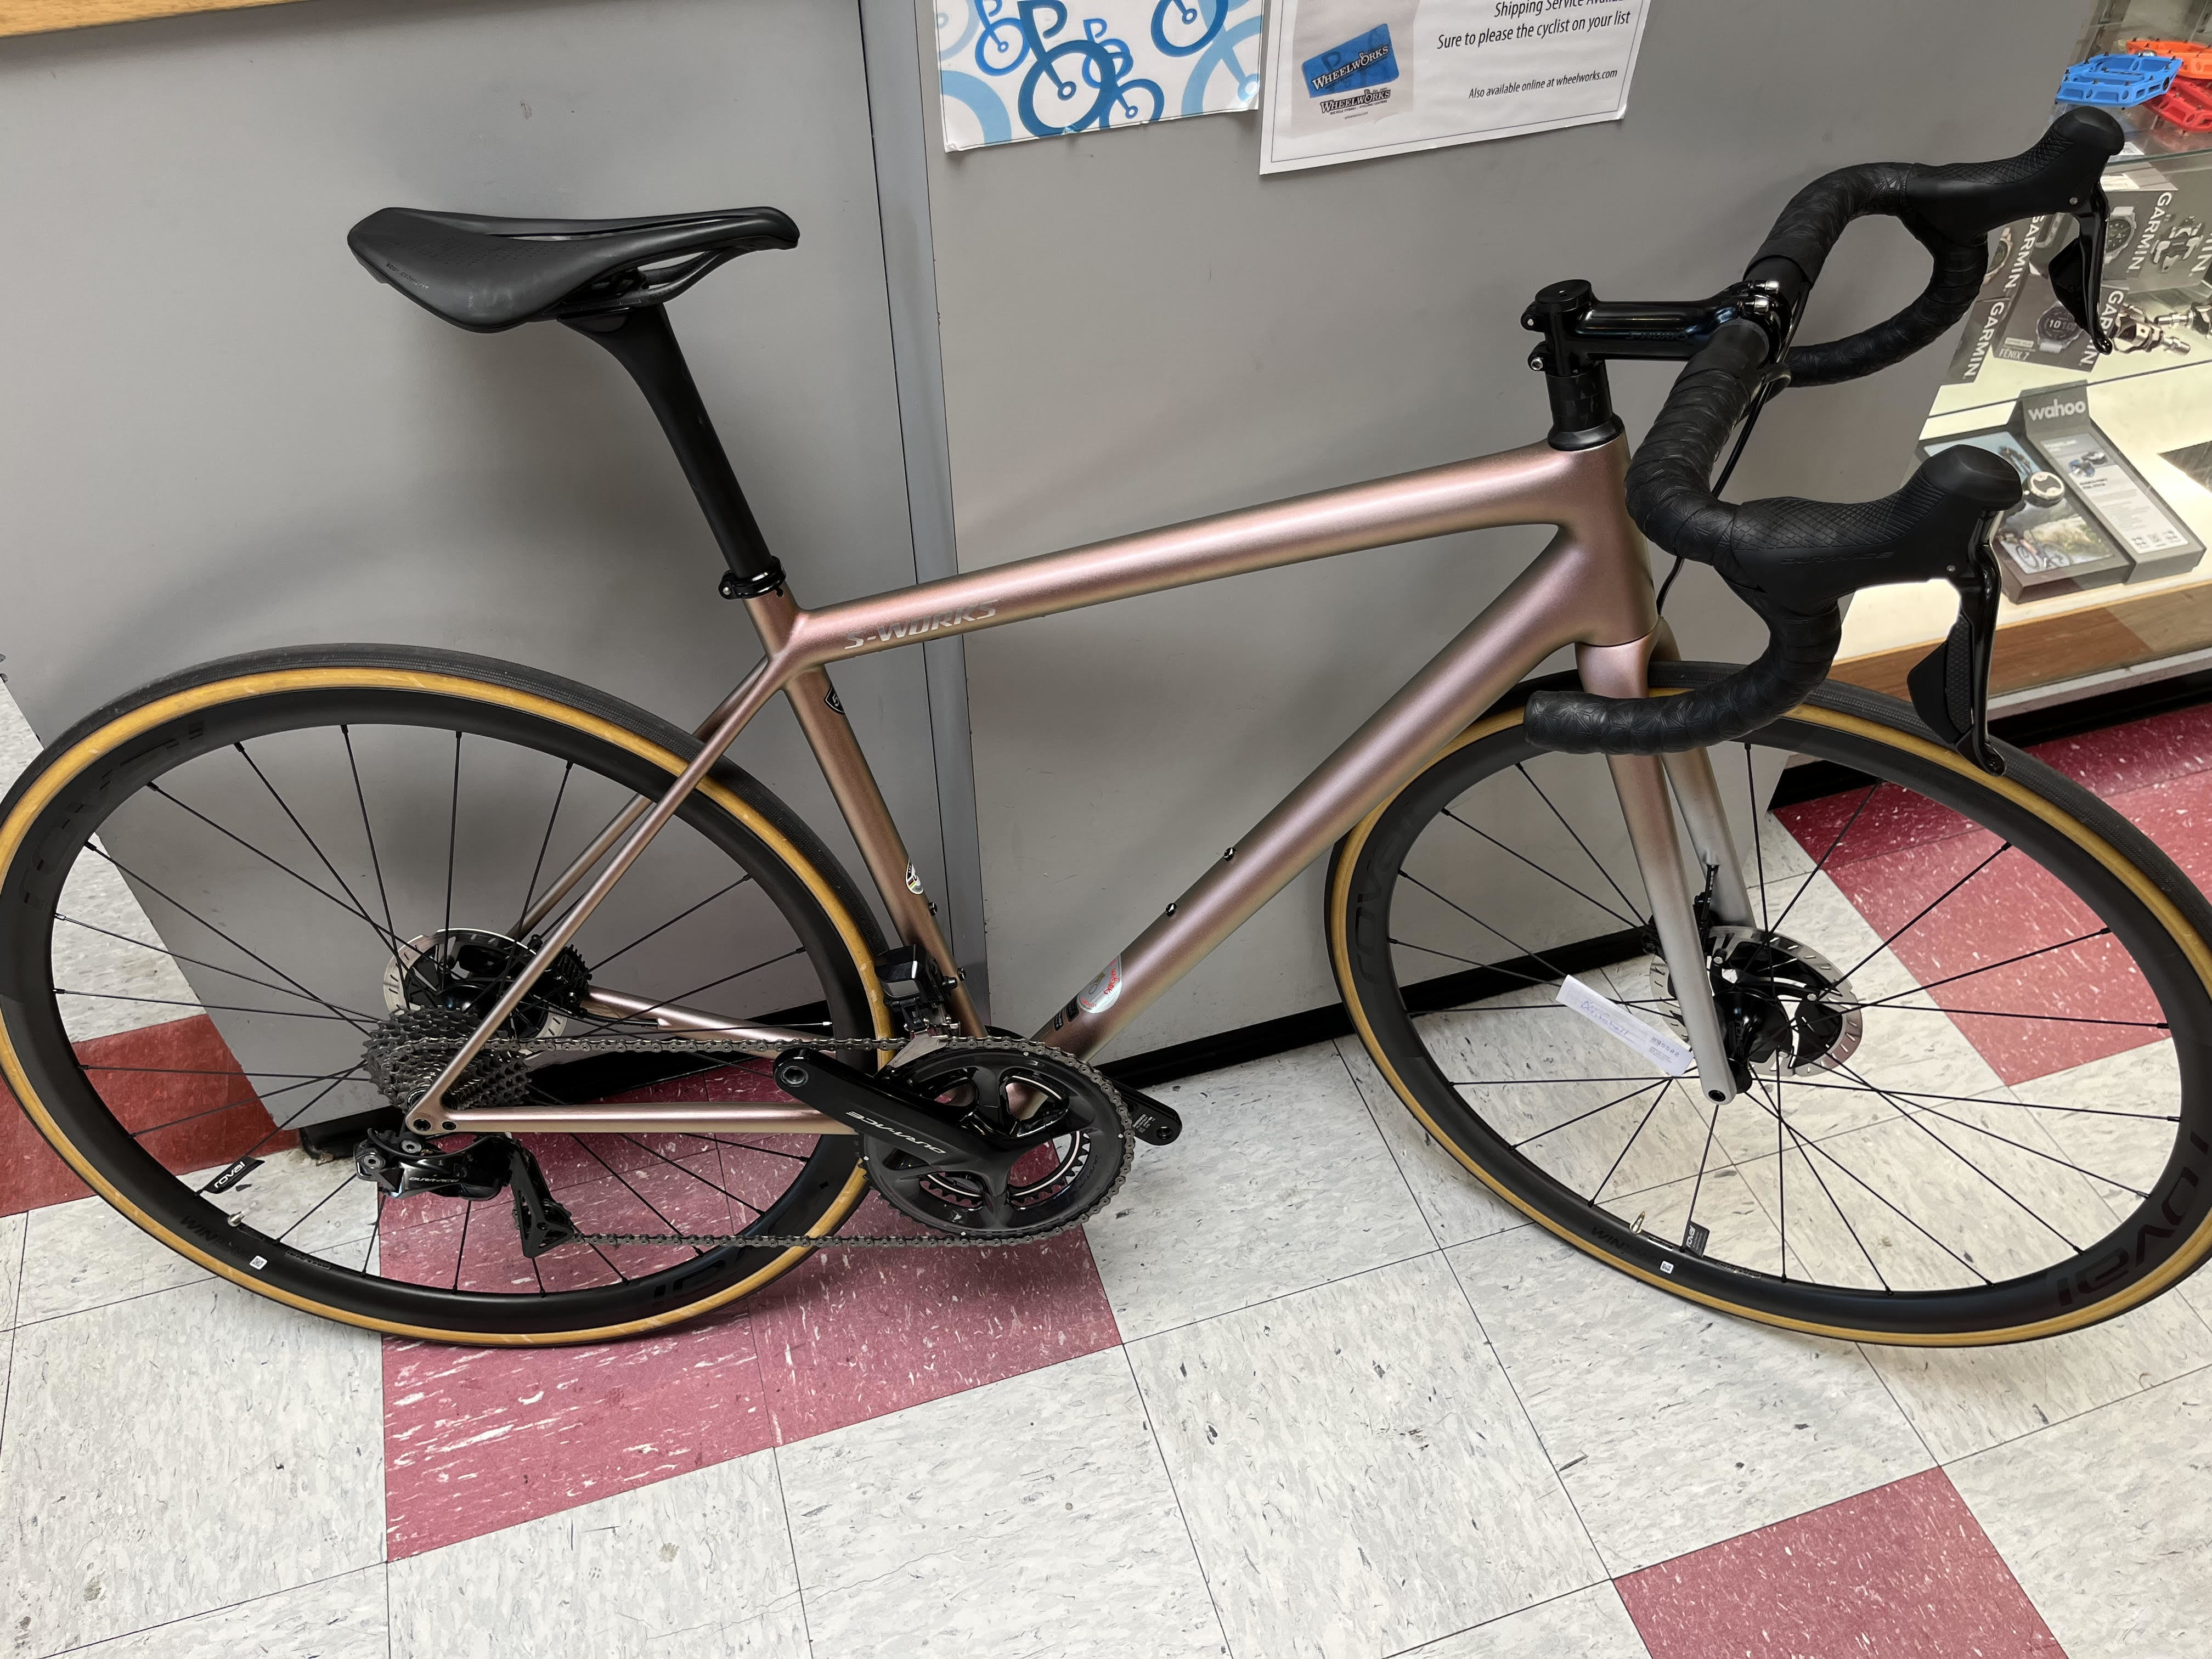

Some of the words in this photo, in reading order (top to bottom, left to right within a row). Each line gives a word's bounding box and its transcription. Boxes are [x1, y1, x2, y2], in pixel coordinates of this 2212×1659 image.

[1494, 1, 1542, 19] Shipping
[1437, 34, 1461, 49] Sure
[1464, 32, 1476, 45] to
[1478, 28, 1513, 47] please
[1516, 23, 1534, 39] the
[1537, 19, 1570, 38] cyclist
[1572, 18, 1585, 31] on
[1587, 15, 1612, 33] your
[1613, 10, 1630, 26] list
[1469, 88, 1485, 99] Also
[1486, 82, 1520, 97] available
[1522, 80, 1545, 92] online
[1546, 78, 1555, 88] at
[1556, 69, 1617, 87] wheelworks.com
[2128, 192, 2172, 272] GARMIN
[1964, 302, 2005, 377] GARMIN
[2023, 351, 2030, 361] 7
[2028, 398, 2086, 421] wahoo
[844, 600, 998, 650] S-WORKS
[845, 1110, 947, 1155] DURA-ACE
[214, 1160, 246, 1189] roval
[1685, 1225, 1696, 1248] roval
